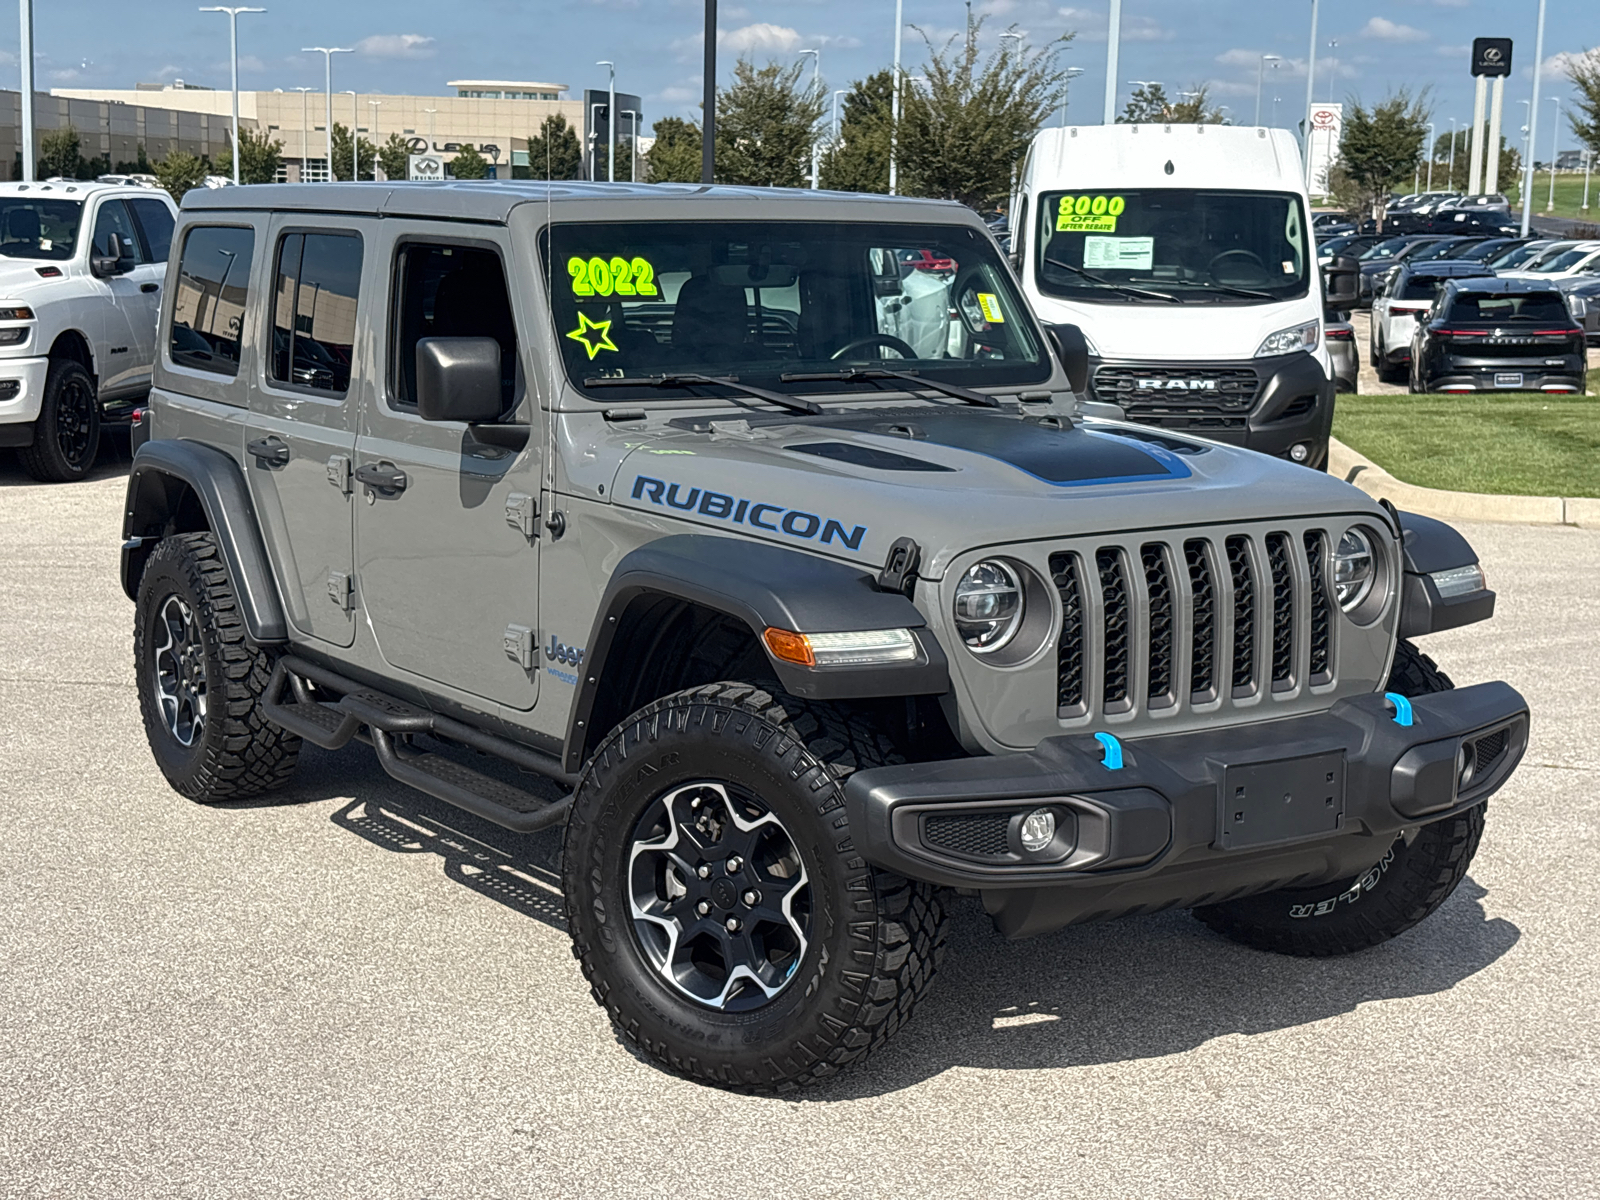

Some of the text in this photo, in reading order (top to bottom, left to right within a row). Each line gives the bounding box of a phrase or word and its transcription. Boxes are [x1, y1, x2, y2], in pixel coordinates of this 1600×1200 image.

[432, 141, 501, 153] LEUS
[1058, 195, 1125, 216] 8000
[1085, 223, 1113, 231] REBATE
[567, 256, 658, 297] 2022
[110, 346, 129, 355] RAM
[1138, 379, 1215, 390] RAM
[631, 474, 868, 551] RUBICON
[593, 750, 681, 953] GOODYEAR
[1288, 830, 1405, 918] NGLER
